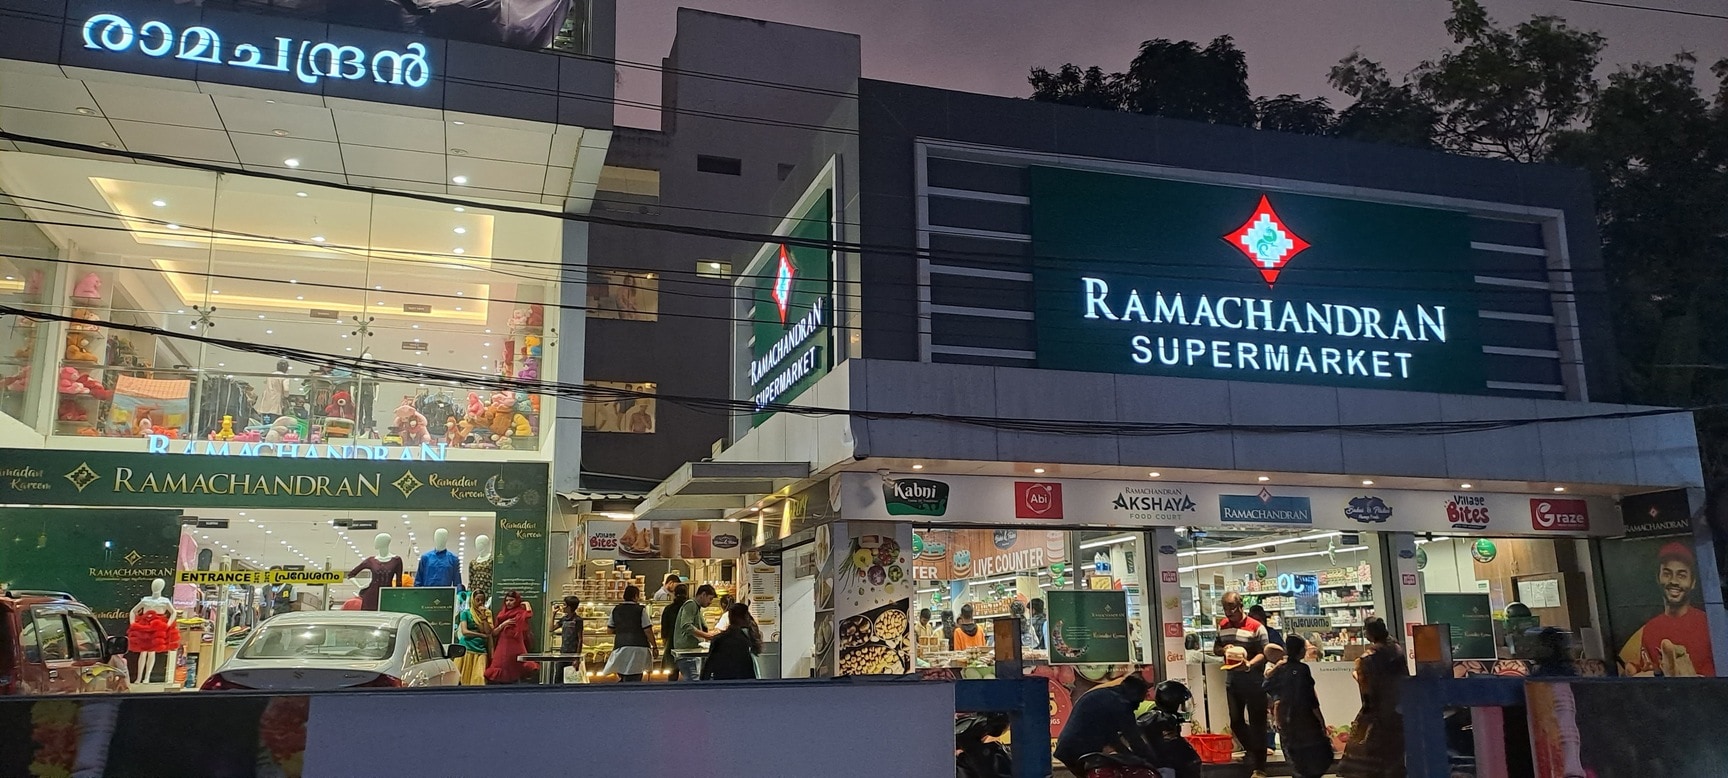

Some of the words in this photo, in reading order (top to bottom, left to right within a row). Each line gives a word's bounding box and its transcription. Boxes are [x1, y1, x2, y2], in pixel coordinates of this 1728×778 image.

[83, 13, 429, 87] രാമചന്ദ്രൻ
[1081, 277, 1447, 343] RAMACHANDRAN
[751, 297, 823, 386] RAMACHANDRAN
[1131, 335, 1413, 379] SUPERMARKET
[756, 346, 816, 411] SUPERMARKET
[148, 434, 448, 461] RAMACHANDRAN
[11, 478, 51, 491] Kareem
[113, 467, 381, 498] RAMACHANDRAN
[429, 473, 478, 487] Ramadan
[451, 488, 485, 500] Kareem
[894, 481, 937, 500] Kabni
[1030, 493, 1048, 504] Abi
[1125, 486, 1182, 495] RAMACHANDRAN
[1112, 492, 1197, 512] AKSHAYA
[1454, 495, 1485, 506] Village
[1223, 507, 1308, 520] RAMACHANDRAN
[1447, 501, 1490, 523] Bites
[1535, 502, 1585, 527] Graze
[500, 518, 537, 530] Ramadan
[1624, 519, 1689, 533] RAMACHANDRAN
[590, 536, 618, 548] Bites
[973, 556, 994, 577] LIVE
[995, 548, 1044, 573] COUNTER
[89, 567, 173, 577] RAMACHANDRAN
[181, 572, 251, 583] ENTRANCE
